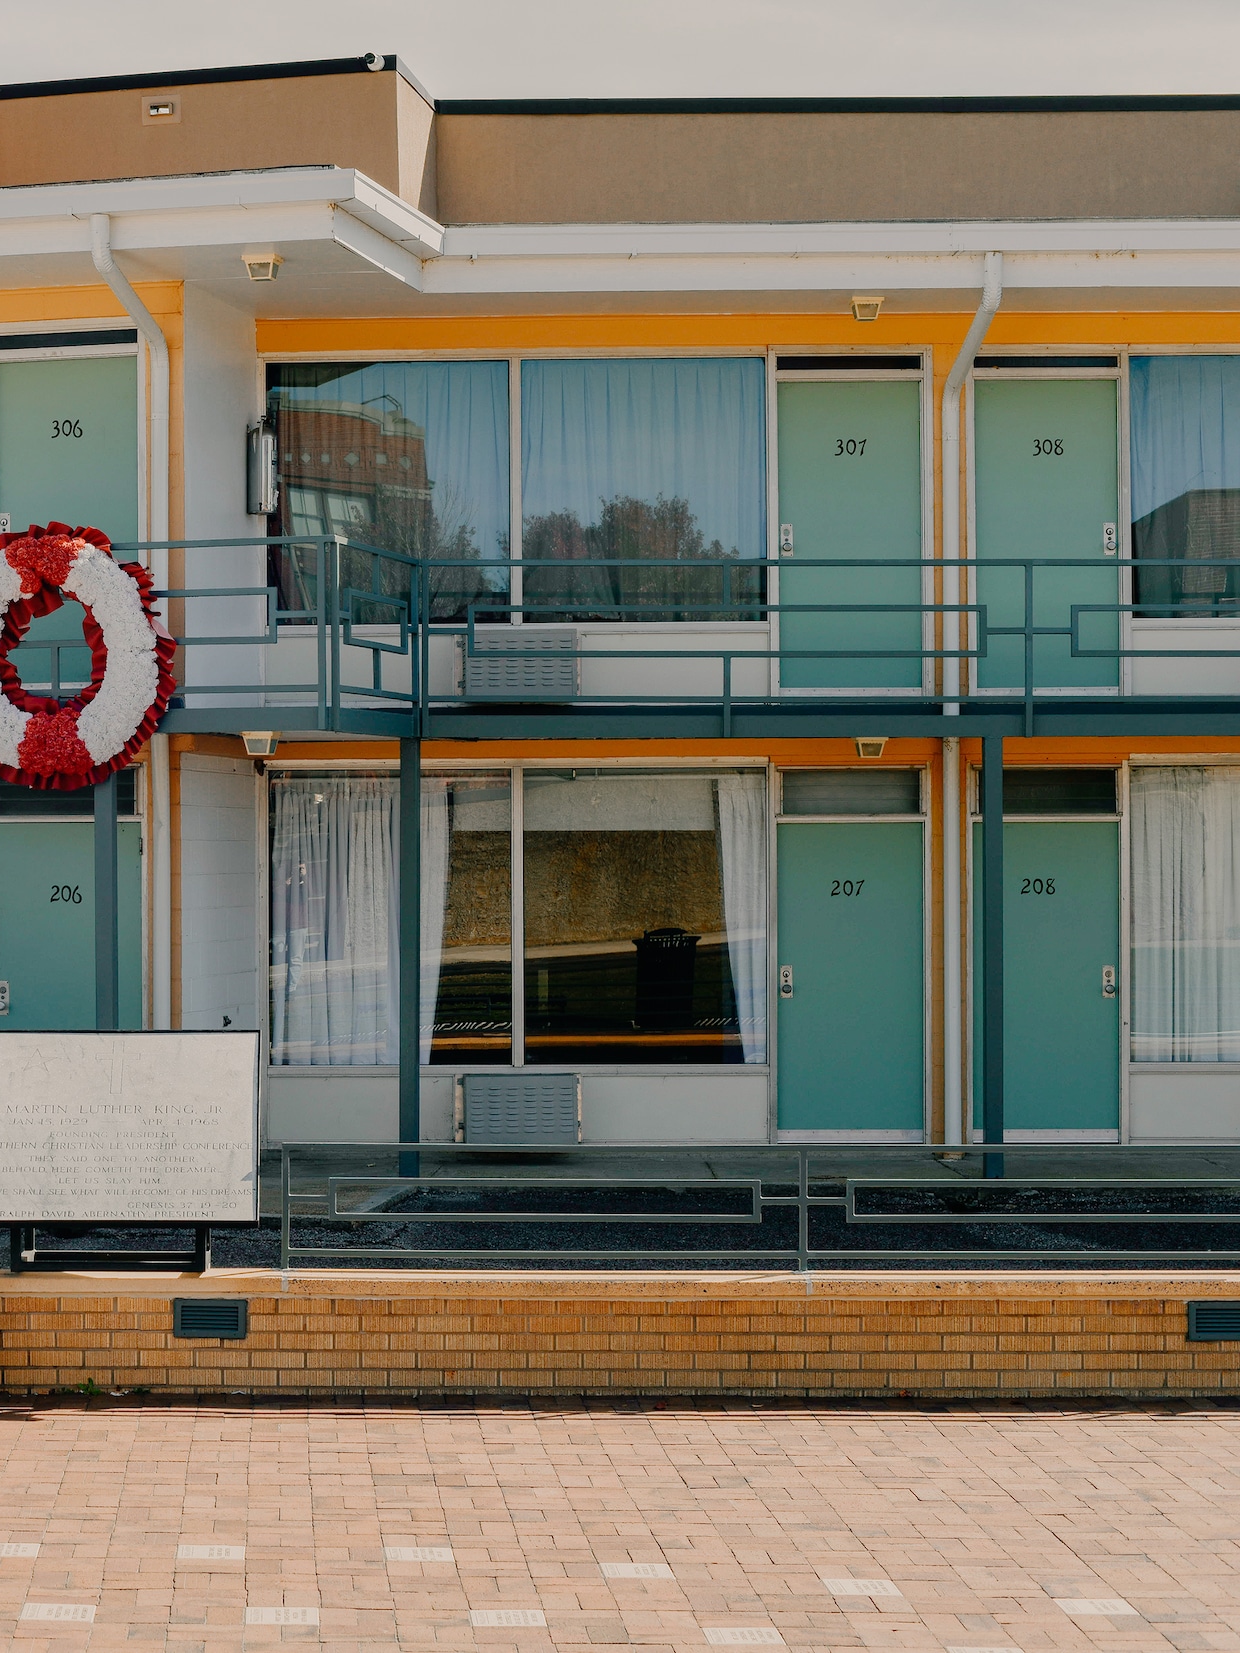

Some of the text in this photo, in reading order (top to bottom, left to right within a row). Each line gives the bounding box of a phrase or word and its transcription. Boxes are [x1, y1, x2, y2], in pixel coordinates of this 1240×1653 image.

[51, 419, 83, 439] 306
[834, 438, 867, 457] 307
[1032, 438, 1064, 457] 308
[50, 884, 83, 904] 206
[830, 879, 865, 897] 207
[1020, 878, 1056, 896] 208
[6, 1104, 68, 1114] MARTIN
[79, 1104, 143, 1114] LUTHER
[60, 1118, 88, 1126] 1929
[190, 1118, 219, 1126] 1968
[42, 1142, 104, 1150] CHRISTIAN
[109, 1142, 178, 1150] LEADERSHIP
[182, 1142, 253, 1150] CONFERENCE
[58, 1177, 79, 1185] LET
[84, 1177, 99, 1185] US
[105, 1177, 133, 1185] SLAY
[0, 1210, 36, 1218] RALPH
[41, 1210, 75, 1218] DAVID
[154, 1210, 217, 1218] PRESIDENT
